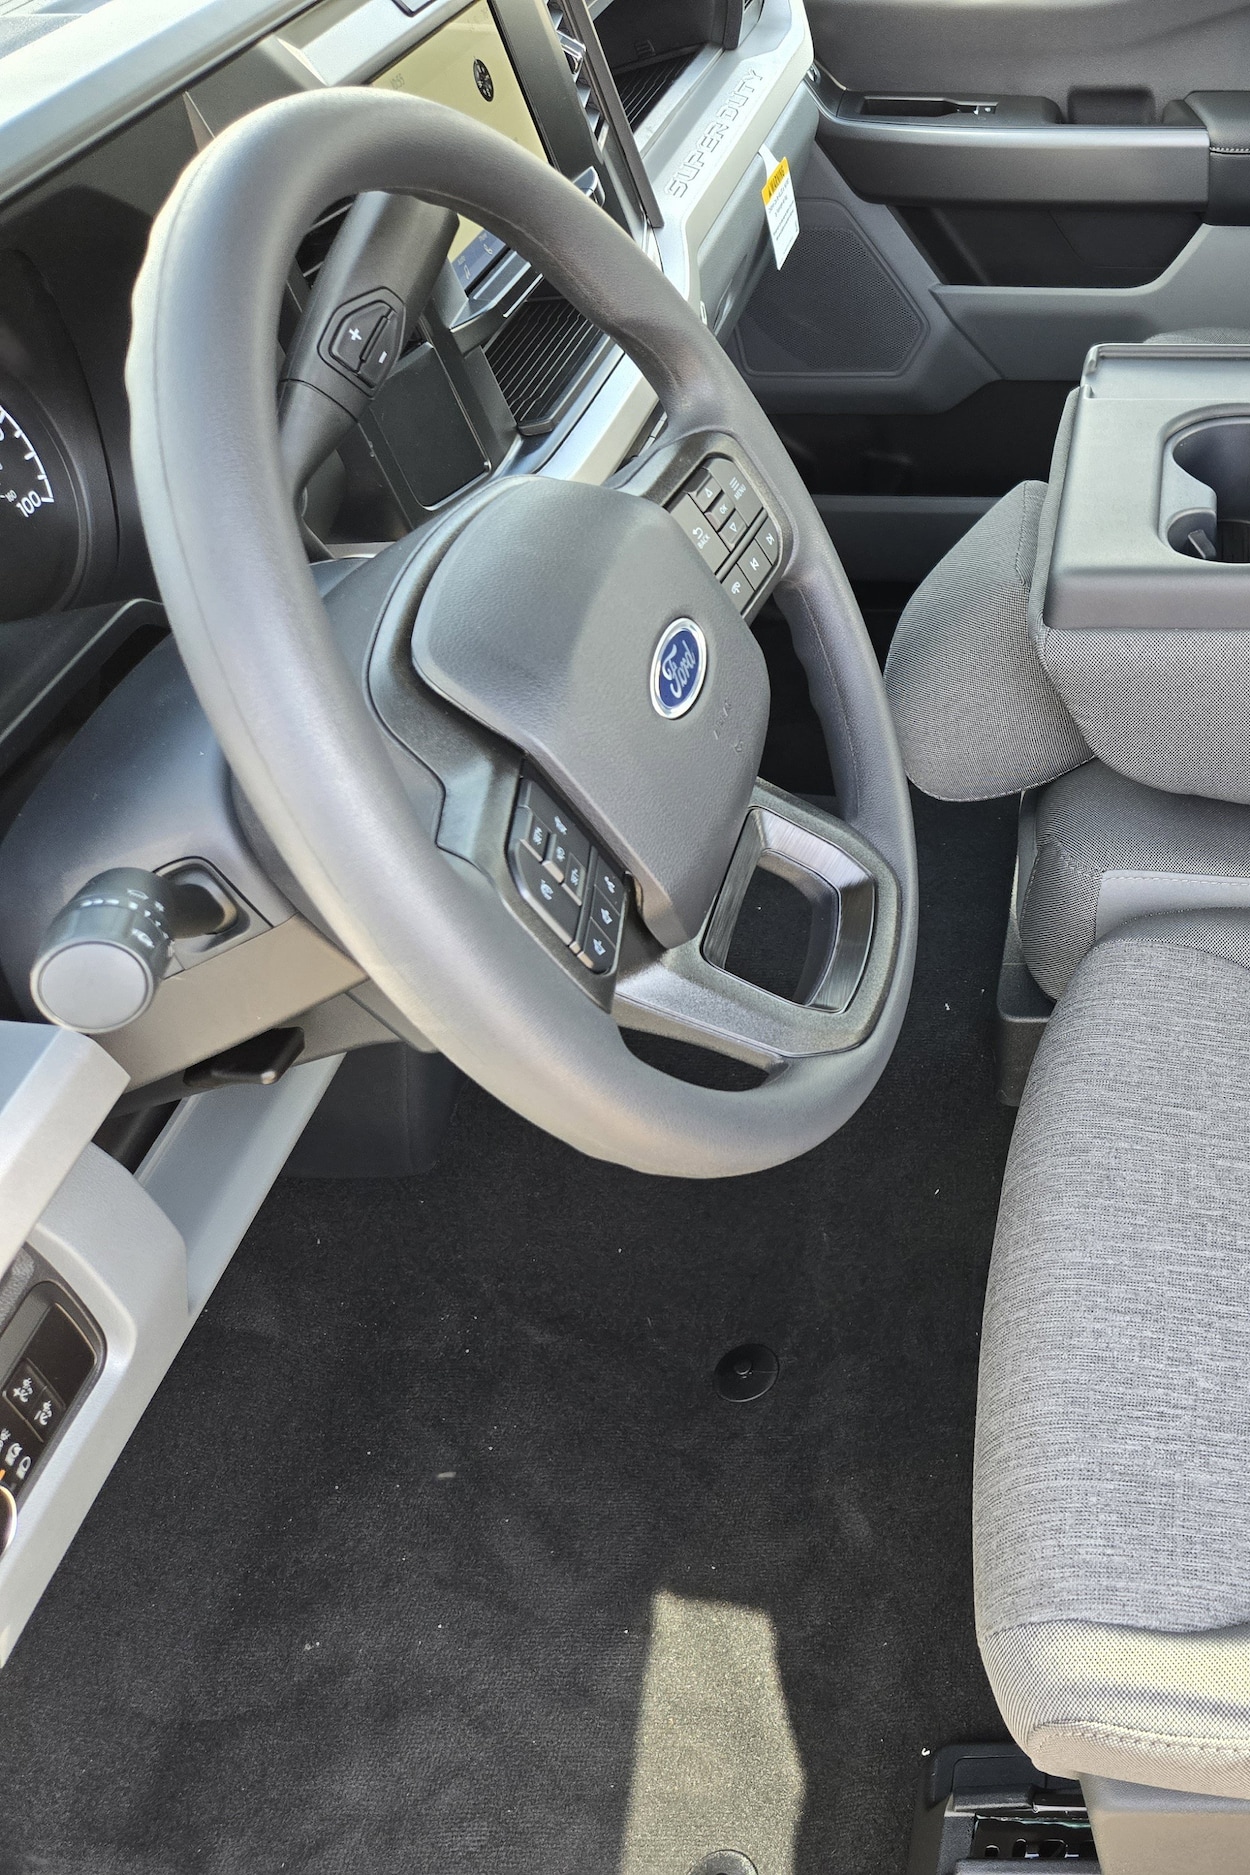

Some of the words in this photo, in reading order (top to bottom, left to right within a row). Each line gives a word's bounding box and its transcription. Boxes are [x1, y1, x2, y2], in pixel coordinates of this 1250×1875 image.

[664, 121, 730, 198] SUPER
[716, 68, 763, 122] DUTY
[734, 483, 747, 500] MENU
[15, 490, 42, 518] 100
[719, 504, 729, 514] OK
[696, 534, 711, 550] BACK
[661, 639, 696, 699] Ford
